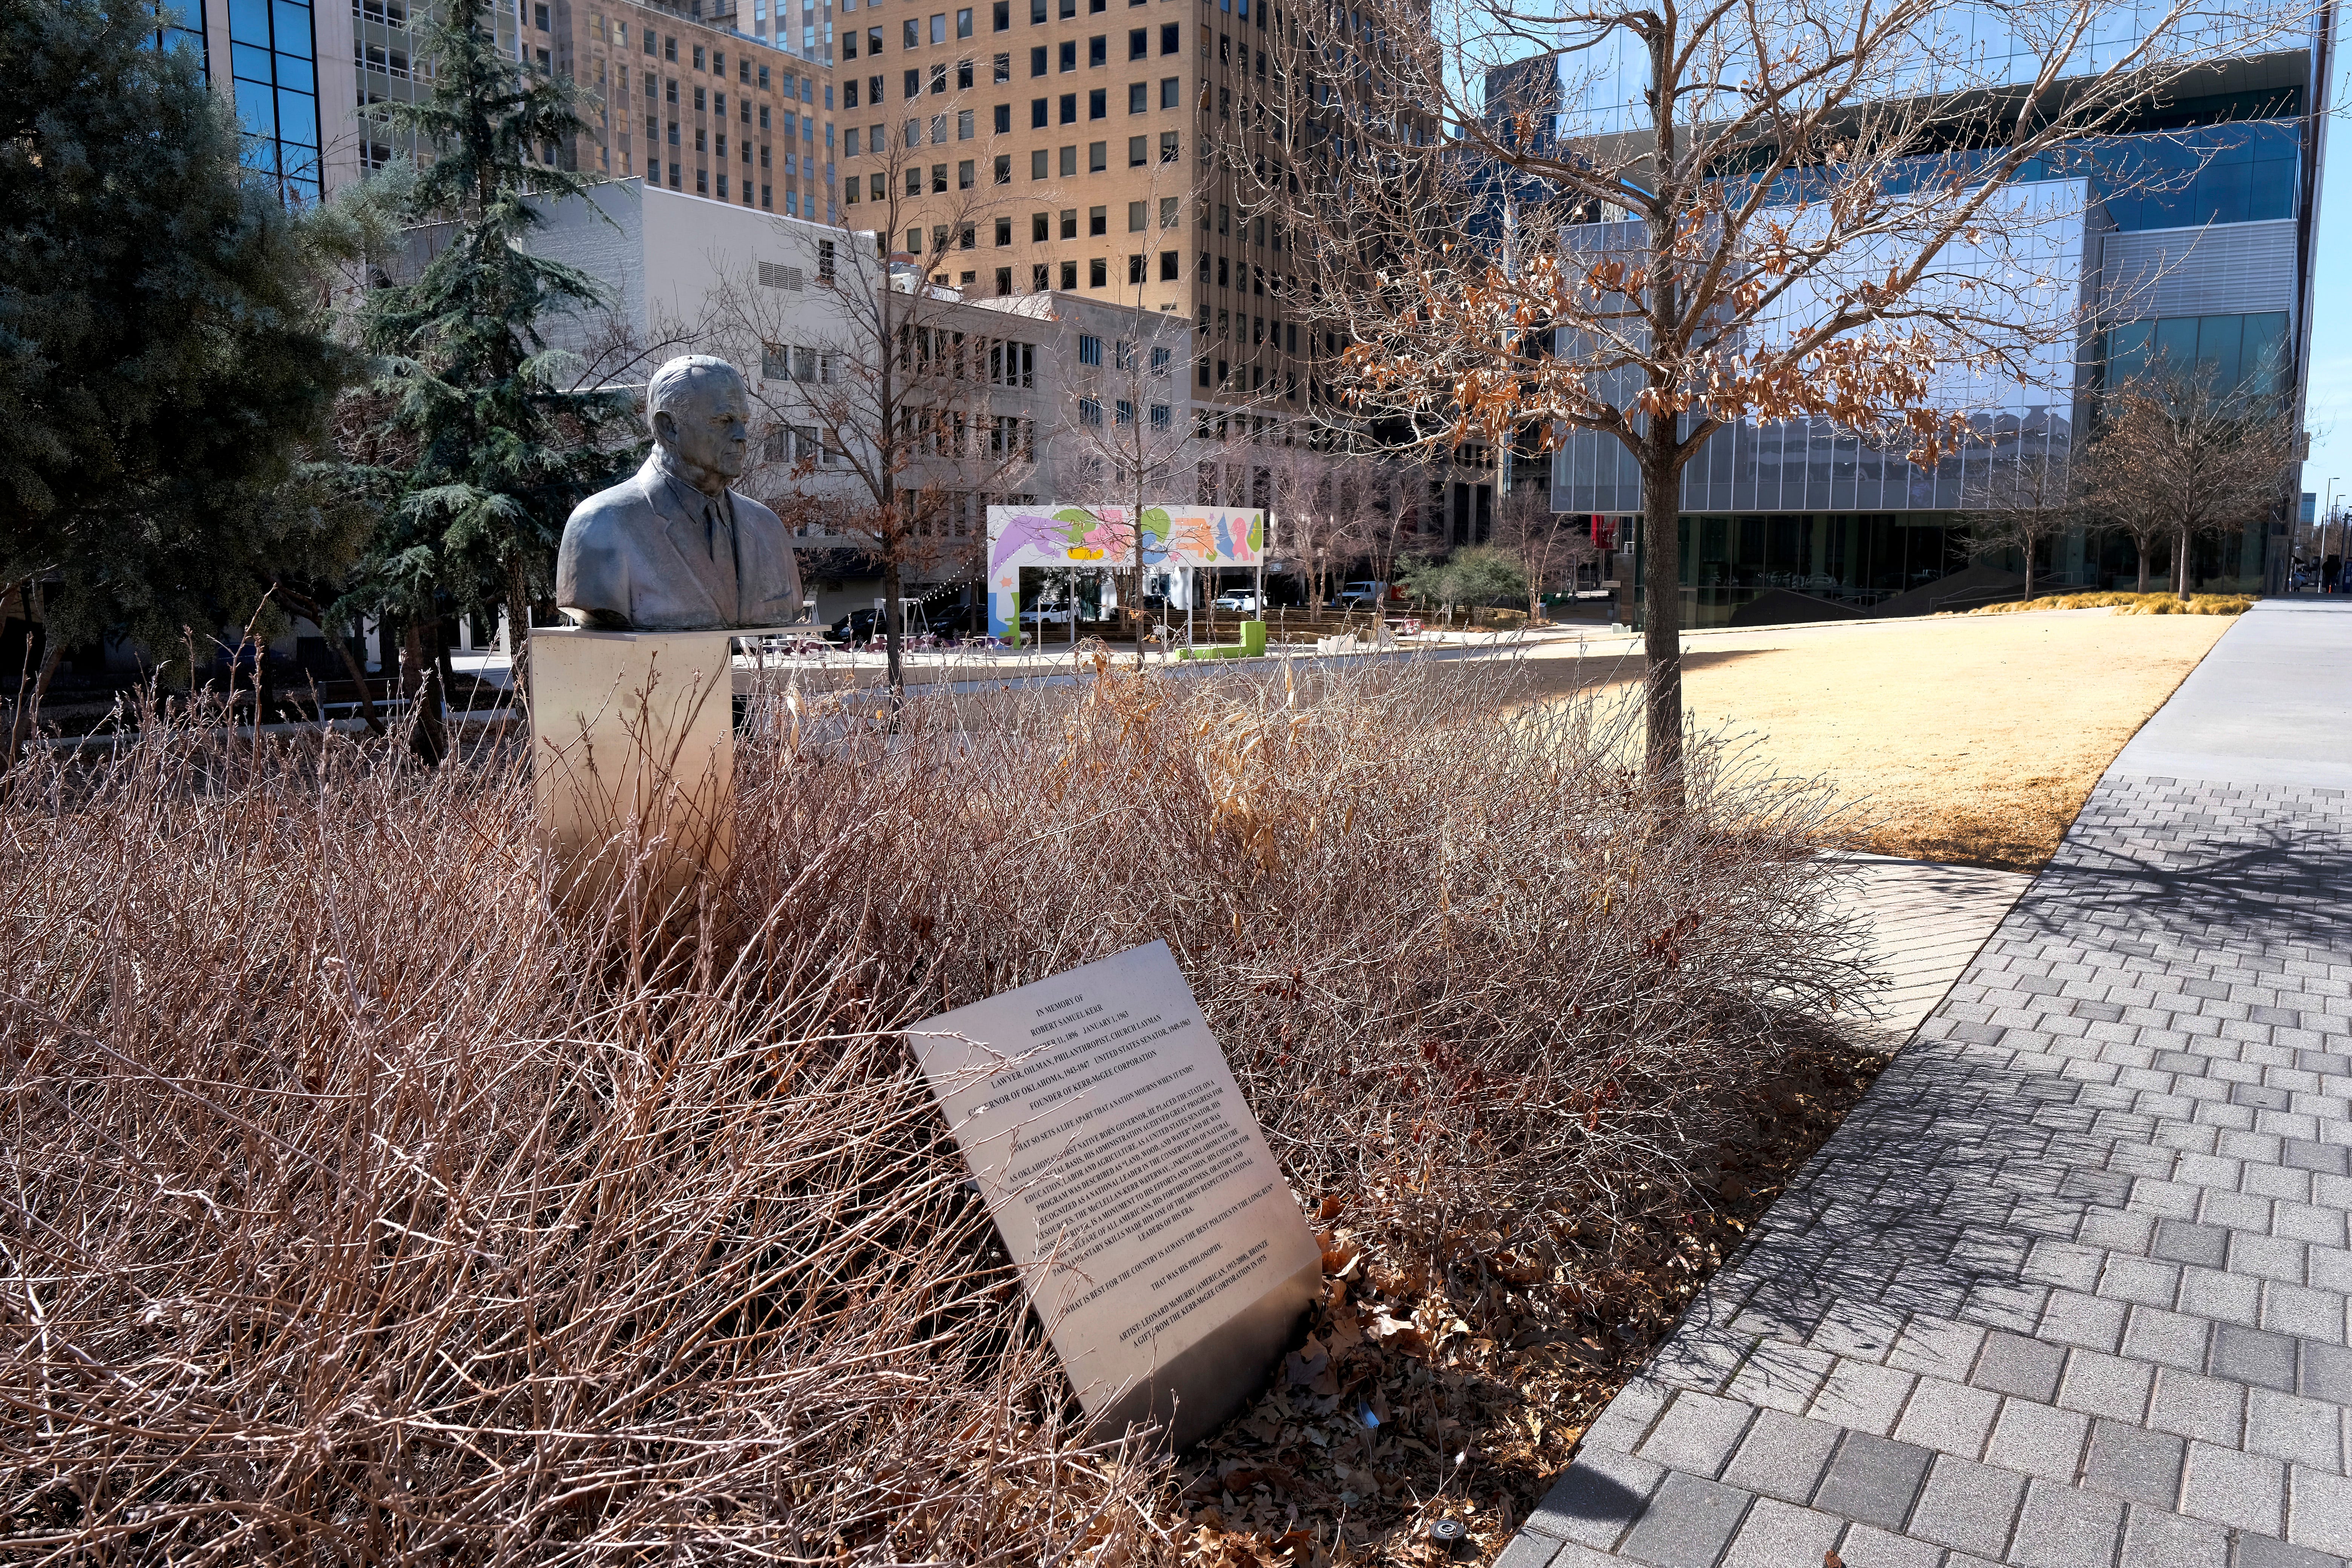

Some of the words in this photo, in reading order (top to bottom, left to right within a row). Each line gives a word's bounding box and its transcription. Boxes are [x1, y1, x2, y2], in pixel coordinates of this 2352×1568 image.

[1030, 1020, 1058, 1037] ROBERT
[1058, 1011, 1086, 1026] SAMUEL
[1084, 1004, 1104, 1016] KERR
[1035, 1008, 1045, 1017] IN
[1044, 997, 1074, 1014] MEMORY
[1075, 994, 1083, 1003] OF
[1065, 1030, 1078, 1041] 1896
[1082, 1017, 1111, 1034] JANUARY
[1116, 1011, 1129, 1020] 1963
[990, 1071, 1024, 1089] LAWYER,
[1024, 1058, 1055, 1075] OILMAN,
[1053, 1035, 1112, 1063] PHILANTHROPIST,
[1110, 1024, 1137, 1040] CHURCH
[1136, 1014, 1162, 1029] LAYMAN
[1011, 1089, 1020, 1099] OF
[1021, 1073, 1064, 1095] OKLAHOMA,
[1063, 1060, 1090, 1077] 1943-1947
[1093, 1049, 1118, 1064] UNITED
[1118, 1040, 1141, 1054] STATES
[1140, 1029, 1170, 1045] SENATOR,
[1168, 1018, 1191, 1033] 1949-1963
[1029, 1091, 1063, 1110] FOUNDER
[1063, 1086, 1072, 1095] OF
[1072, 1068, 1114, 1092] KERR-McGEE
[1113, 1049, 1157, 1073] CORPORATION
[1009, 1173, 1018, 1184] AS
[1076, 1134, 1100, 1150] NATIVE
[1099, 1126, 1116, 1139] BORN
[1116, 1112, 1149, 1131] GOVERNOR,
[1147, 1107, 1156, 1116] HE
[1155, 1098, 1177, 1112] PLACED
[1176, 1092, 1188, 1102] THE
[1187, 1084, 1204, 1097] STATE
[1203, 1081, 1211, 1089] ON
[1031, 1136, 1040, 1145] SO
[1040, 1128, 1056, 1141] SETS
[1060, 1119, 1075, 1132] LIFE
[1075, 1110, 1093, 1125] APART
[1093, 1103, 1109, 1116] THAT
[1112, 1092, 1135, 1107] NATION
[1134, 1081, 1158, 1097] MOURNS
[1156, 1074, 1173, 1086] WHEN
[1178, 1064, 1194, 1076] ENDS?
[1083, 1150, 1095, 1161] HIS
[1095, 1126, 1143, 1156] ADMINISTRATION
[1170, 1104, 1187, 1118] GREAT
[1187, 1092, 1213, 1109] PROGRESS
[1212, 1087, 1223, 1097] FOR
[1024, 1179, 1064, 1204] EDUCATION,
[1061, 1169, 1084, 1185] LABOR
[1084, 1163, 1096, 1174] AND
[1097, 1142, 1138, 1168] AGRICULTURE.
[1138, 1138, 1145, 1147] AS
[1169, 1116, 1188, 1131] STATES
[1187, 1106, 1213, 1121] SENATOR,
[1211, 1100, 1220, 1110] HIS
[1036, 1191, 1069, 1213] PROGRAM
[1067, 1184, 1082, 1195] WAS
[1081, 1167, 1115, 1189] DESCRIBED
[1115, 1163, 1122, 1173] AS
[1141, 1144, 1161, 1158] WOOD,
[1192, 1122, 1202, 1133] AND
[1202, 1118, 1211, 1127] HE
[1209, 1112, 1221, 1122] WAS
[1074, 1208, 1088, 1220] THE
[1087, 1181, 1139, 1214] McCLELLAN-KERR
[1138, 1165, 1171, 1185] WATERWAY,
[1192, 1137, 1222, 1157] OKLAHOMA
[1220, 1133, 1228, 1142] TO
[1227, 1128, 1239, 1138] THE
[1078, 1196, 1086, 1206] AS
[1089, 1178, 1120, 1199] NATIONAL
[1119, 1166, 1143, 1183] LEADER
[1142, 1162, 1150, 1171] IN
[1148, 1156, 1161, 1167] THE
[1161, 1136, 1200, 1161] CONSERVATION
[1199, 1132, 1207, 1140] OF
[1206, 1121, 1230, 1137] NATURAL
[1090, 1217, 1098, 1226] IS
[1101, 1196, 1135, 1220] MONUMENT
[1134, 1193, 1144, 1201] TO
[1143, 1187, 1154, 1197] HIS
[1153, 1174, 1178, 1191] EFFORTS
[1178, 1168, 1188, 1179] AND
[1187, 1158, 1208, 1172] VISION.
[1207, 1152, 1217, 1162] HIS
[1216, 1139, 1240, 1157] CONCERN
[1239, 1135, 1250, 1144] FOR
[1098, 1226, 1106, 1236] OF
[1107, 1220, 1119, 1232] ALL
[1119, 1202, 1154, 1225] AMERICANS,
[1152, 1195, 1163, 1206] HIS
[1162, 1170, 1211, 1200] FORTHRIGHTNESS,
[1209, 1156, 1233, 1173] ORATORY
[1233, 1151, 1243, 1161] AND
[1104, 1230, 1125, 1247] SKILLS
[1125, 1220, 1143, 1236] MADE
[1142, 1213, 1155, 1225] HIM
[1154, 1207, 1167, 1218] ONE
[1166, 1202, 1174, 1211] OF
[1173, 1196, 1186, 1207] THE
[1185, 1187, 1200, 1201] MOST
[1200, 1171, 1229, 1192] RESPECTED
[1228, 1158, 1254, 1176] NATIONAL
[1138, 1222, 1164, 1242] LEADERS
[1164, 1217, 1171, 1227] OF
[1171, 1212, 1182, 1222] HIS
[1181, 1206, 1194, 1217] ERA.
[1083, 1294, 1090, 1304] IS
[1089, 1285, 1106, 1300] BEST
[1105, 1278, 1119, 1291] FOR
[1118, 1269, 1132, 1282] THE
[1131, 1253, 1158, 1274] COUNTRY
[1157, 1250, 1164, 1258] IS
[1164, 1237, 1185, 1255] ALWAYS
[1184, 1230, 1197, 1242] THE
[1196, 1222, 1210, 1235] BEST
[1208, 1208, 1233, 1227] POLITICS
[1231, 1205, 1239, 1213] IN
[1237, 1199, 1249, 1210] THE
[1248, 1190, 1262, 1204] LONG
[1150, 1276, 1167, 1291] THAT
[1165, 1269, 1179, 1281] WAS
[1178, 1263, 1189, 1274] HIS
[1188, 1242, 1223, 1268] PHILOSOPHY.
[1119, 1323, 1142, 1343] ARTIST:
[1141, 1305, 1169, 1327] LEONARD
[1168, 1286, 1196, 1309] McMURRY
[1196, 1267, 1228, 1293] (AMERICAN,
[1226, 1253, 1250, 1272] 1913-2008),
[1248, 1239, 1269, 1257] BRONZE
[1138, 1330, 1155, 1344] GIFT
[1168, 1311, 1182, 1324] THE
[1181, 1288, 1216, 1316] KERR-McGEE
[1215, 1264, 1251, 1293] CORPORATION
[1250, 1260, 1257, 1269] IN
[1257, 1254, 1267, 1265] 1975
